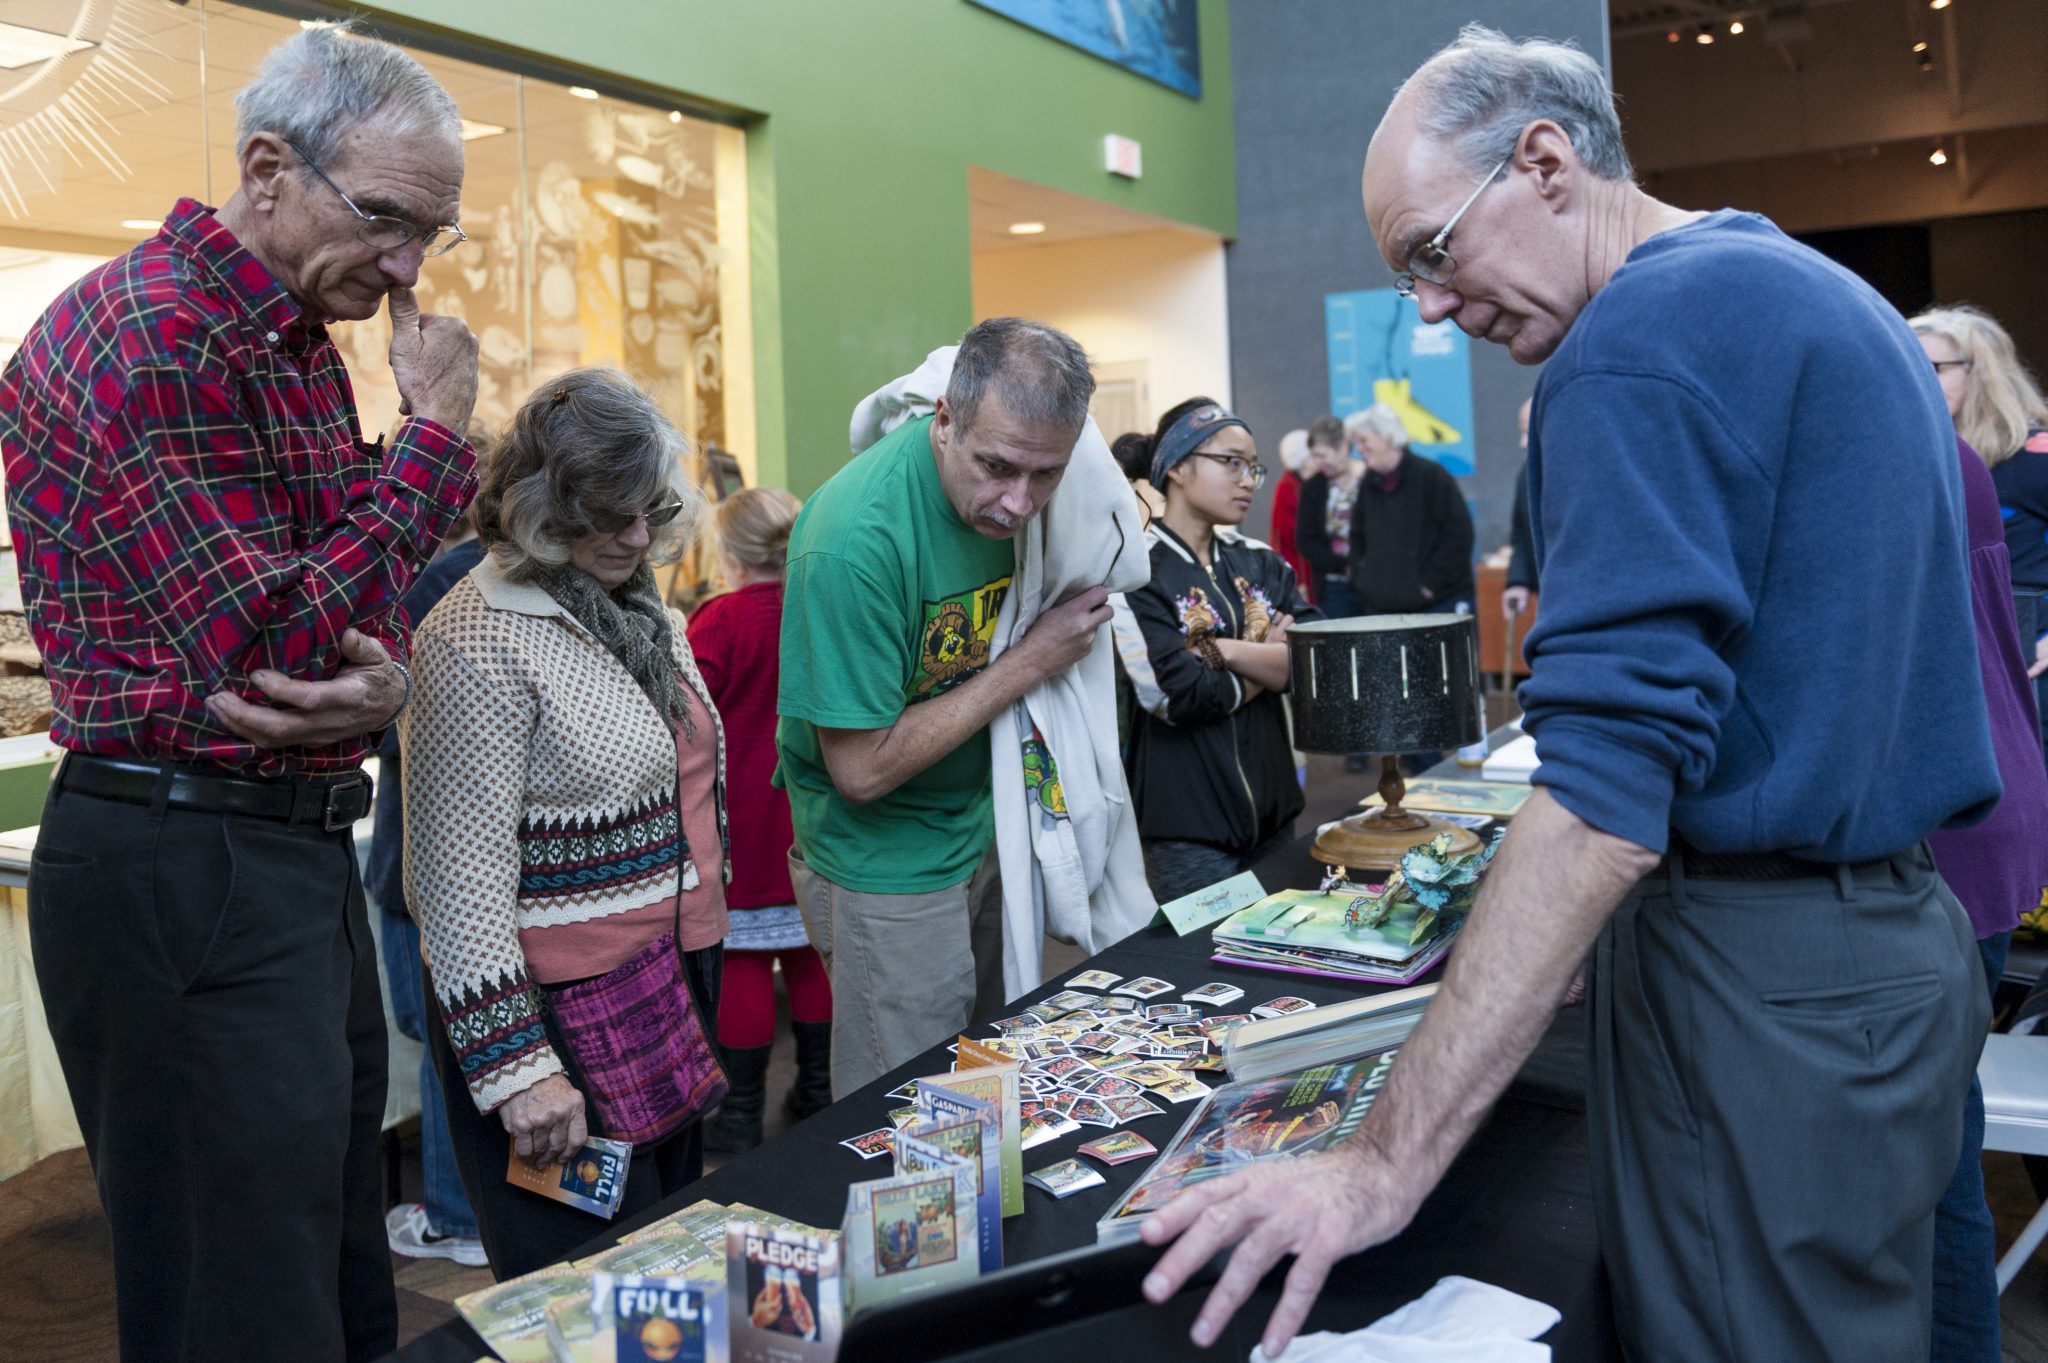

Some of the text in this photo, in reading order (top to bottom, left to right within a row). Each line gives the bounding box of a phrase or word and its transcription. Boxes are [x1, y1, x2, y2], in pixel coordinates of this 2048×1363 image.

[594, 1154, 617, 1199] FULL
[746, 1237, 819, 1272] PLEDGE
[618, 1288, 699, 1321] FULL
